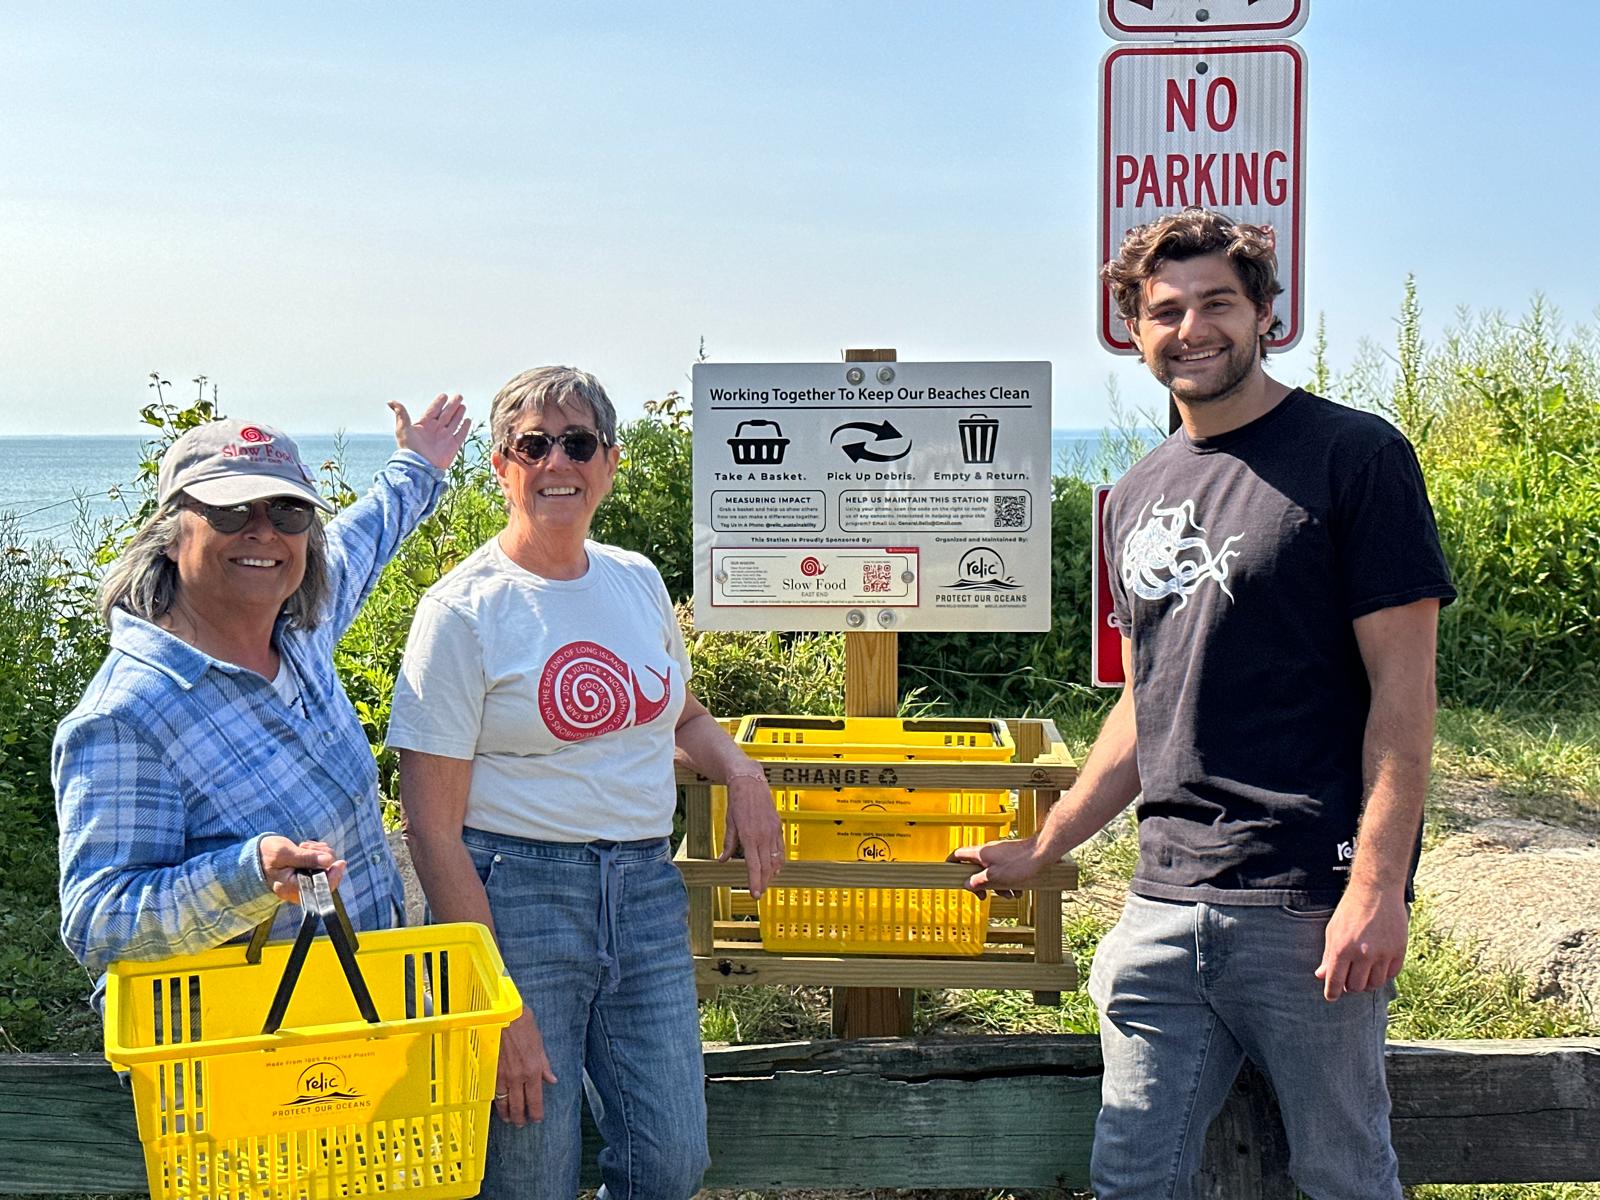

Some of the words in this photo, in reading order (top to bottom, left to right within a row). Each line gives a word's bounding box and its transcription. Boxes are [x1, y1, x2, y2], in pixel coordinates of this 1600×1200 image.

[1166, 76, 1237, 132] NO
[1116, 150, 1288, 208] PARKING
[710, 388, 769, 404] Working
[772, 388, 836, 404] Together
[838, 388, 854, 400] To
[858, 388, 893, 403] Keep
[897, 388, 924, 400] Our
[928, 387, 986, 400] Beaches
[990, 386, 1030, 399] Clean
[222, 444, 259, 458] Slow
[265, 444, 294, 464] Food
[715, 472, 742, 480] Take
[761, 472, 806, 480] Basket.
[827, 472, 852, 480] Pick
[856, 472, 870, 482] Up
[875, 472, 915, 480] Debris.
[934, 472, 971, 482] Empty
[974, 472, 982, 480] &
[986, 472, 1029, 480] Return.
[967, 557, 997, 578] relic
[782, 579, 812, 590] Slow
[816, 578, 846, 590] Food
[564, 649, 574, 657] OF
[576, 647, 597, 655] LONG
[552, 655, 564, 670] END
[600, 651, 624, 672] ISLAND
[572, 664, 601, 675] JUSTICE
[544, 669, 554, 687] EAST
[607, 676, 627, 724] NOURISHING
[544, 707, 555, 720] ON
[566, 704, 581, 720] FAIR
[591, 698, 609, 720] CLEAN
[783, 769, 870, 784] CHANGE
[863, 844, 885, 859] relic
[306, 1072, 338, 1092] relic
[272, 1107, 311, 1116] PROTECT
[336, 1101, 371, 1110] OCEANS
